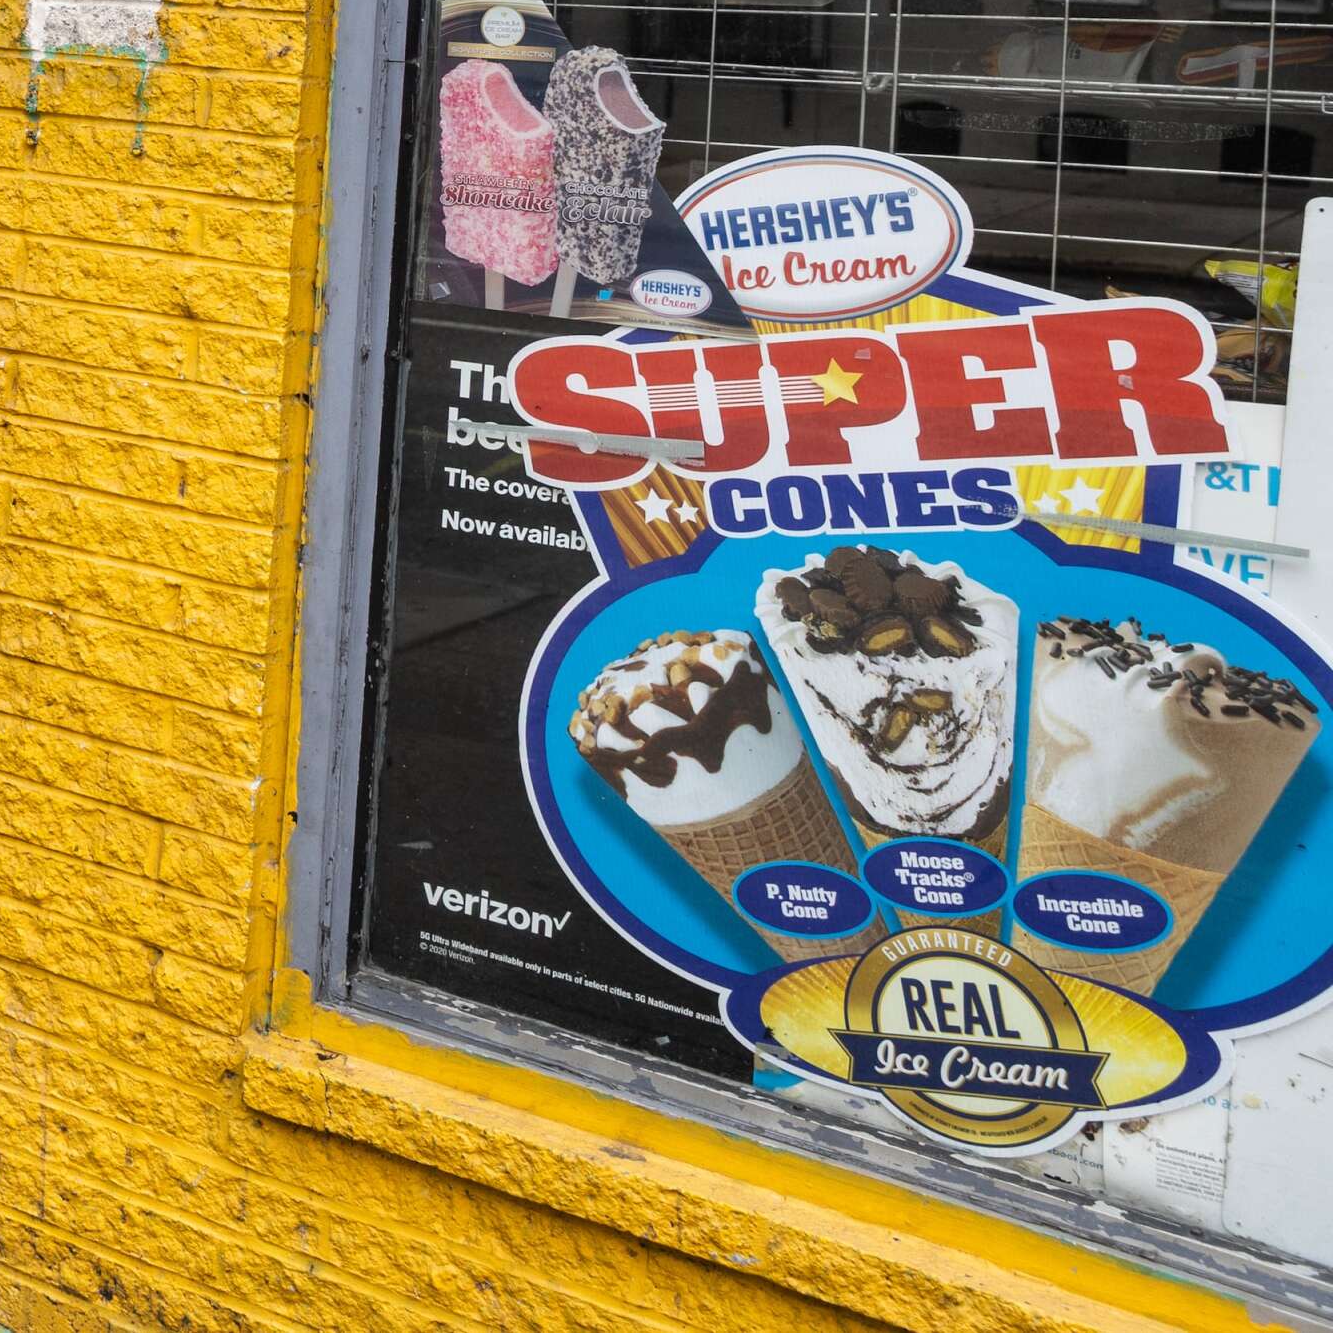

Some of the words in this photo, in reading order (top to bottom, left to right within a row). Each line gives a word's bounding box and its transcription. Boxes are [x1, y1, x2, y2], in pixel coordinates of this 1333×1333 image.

[454, 174, 535, 189] STRAWBERRY
[565, 182, 648, 200] CHOCOLATE
[440, 185, 555, 213] Shortcake
[562, 196, 653, 226] Eclair
[700, 190, 915, 251] HERSHEY'S
[721, 254, 776, 291] Ice
[783, 251, 917, 287] Cream
[641, 280, 702, 298] HERSHEY'S
[644, 294, 658, 305] Ice
[661, 295, 698, 311] Cream
[514, 307, 1231, 483] SUPER
[444, 467, 490, 492] The
[712, 468, 1021, 533] CONES
[441, 509, 496, 536] Now
[900, 851, 964, 870] Moose
[766, 883, 785, 901] P.
[788, 885, 837, 907] Nutty
[913, 886, 964, 905] Cone
[1037, 893, 1144, 918] Incredible
[423, 882, 553, 938] verizon
[780, 900, 828, 920] Cone
[1066, 914, 1121, 935] Cone
[429, 945, 447, 956] 2020
[881, 931, 1013, 968] GUARANTEED
[420, 930, 431, 941] 5G
[431, 934, 450, 946] Ultra
[451, 939, 489, 958] Wideband
[489, 951, 524, 967] available
[525, 961, 543, 975] only
[543, 966, 551, 976] in
[552, 970, 573, 984] parts
[574, 976, 583, 985] of
[584, 979, 608, 993] select
[609, 986, 634, 1000] cities.
[635, 993, 646, 1004] 5G
[647, 997, 694, 1018] Nationwide
[900, 977, 1022, 1040] REAL
[874, 1039, 929, 1077] Ice
[940, 1045, 1069, 1091] Cream
